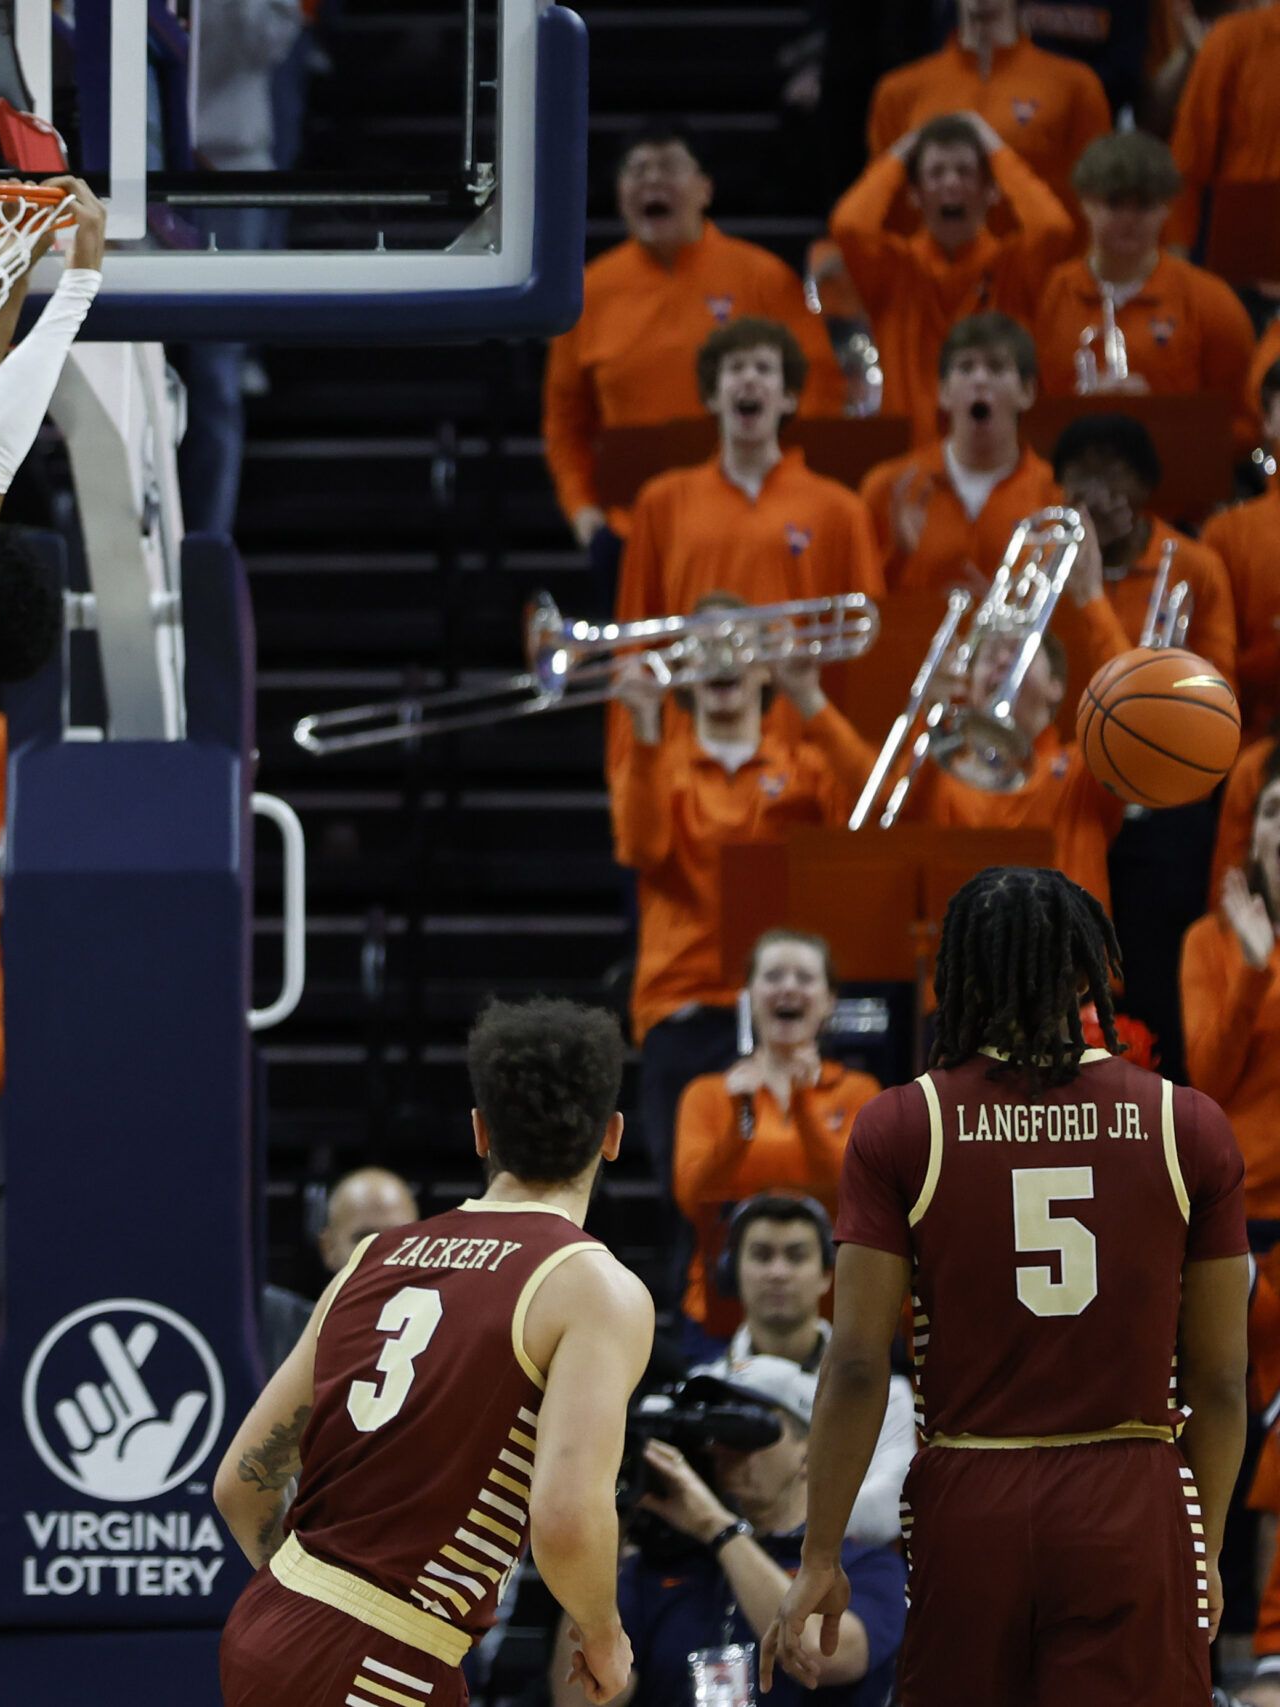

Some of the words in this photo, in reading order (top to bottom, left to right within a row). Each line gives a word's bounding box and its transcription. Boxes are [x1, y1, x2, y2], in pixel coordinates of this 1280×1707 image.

[956, 1103, 1098, 1142] LANGFORD
[1108, 1102, 1149, 1140] JR.
[383, 1236, 522, 1271] ZACKERY
[1011, 1166, 1098, 1317] 5
[346, 1286, 443, 1432] 3
[24, 1511, 224, 1551] VIRGINIA
[23, 1555, 225, 1596] LOTTERY
